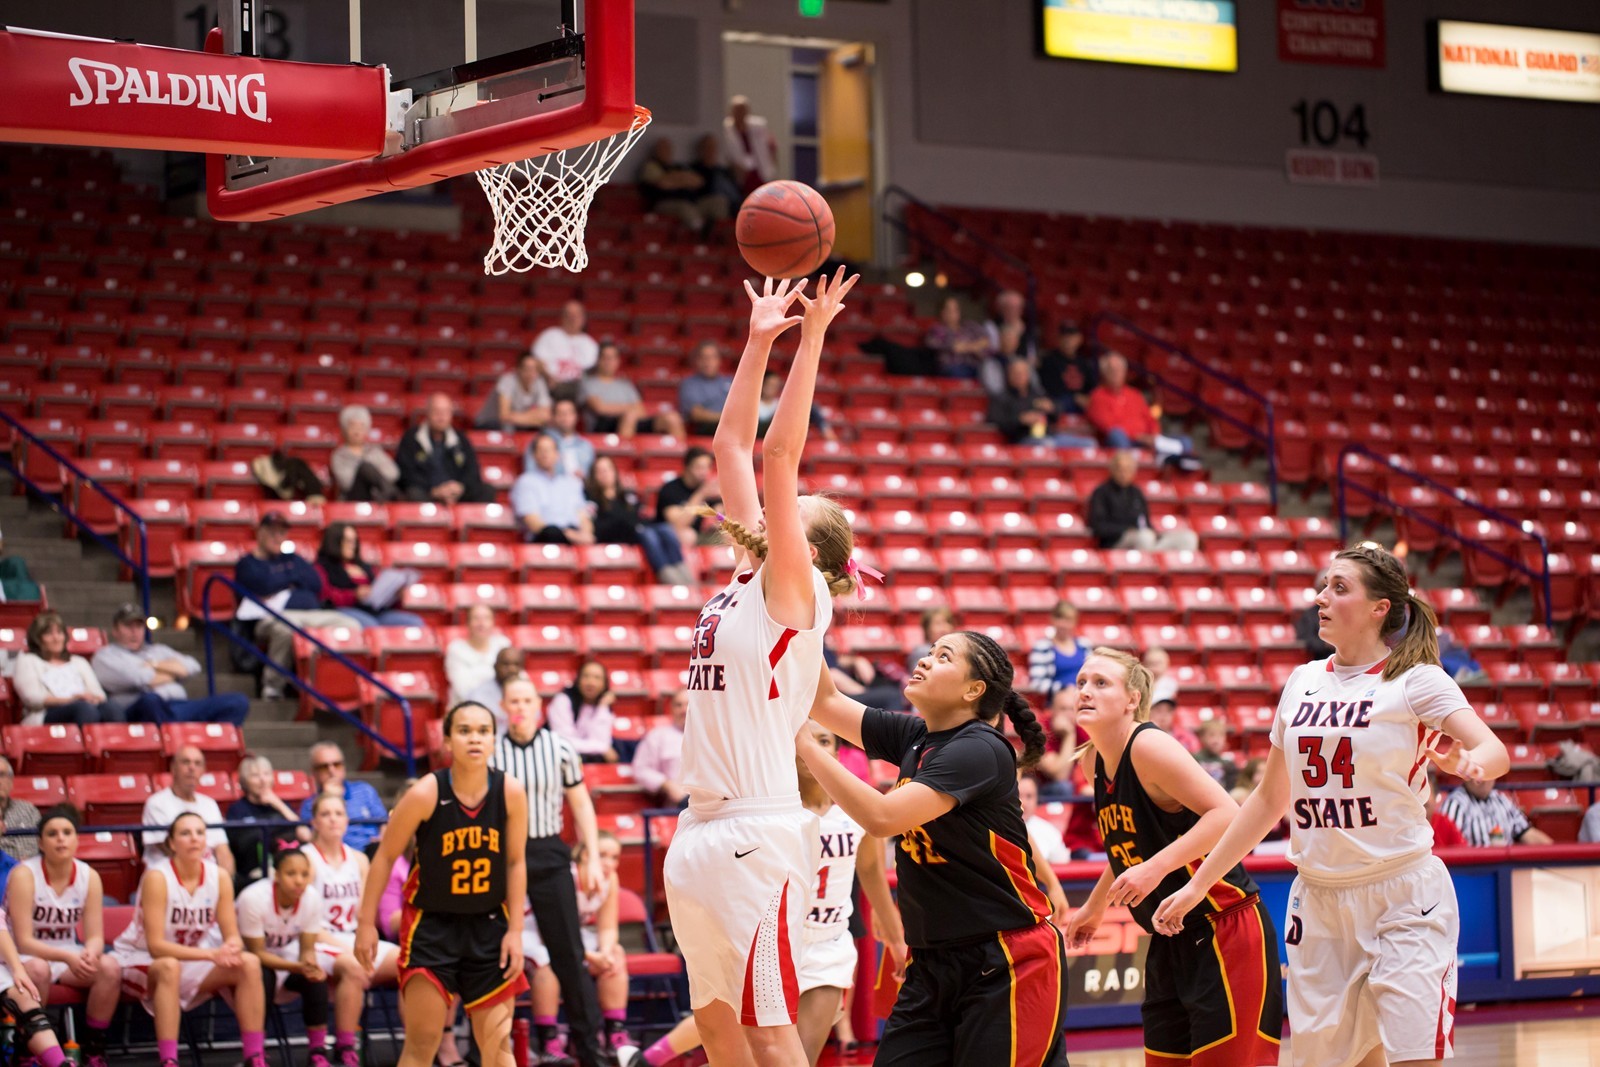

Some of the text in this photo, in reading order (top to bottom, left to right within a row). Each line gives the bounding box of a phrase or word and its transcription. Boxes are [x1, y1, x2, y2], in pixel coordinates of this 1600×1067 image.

[1443, 44, 1578, 72] NATIONAL GUARD
[69, 57, 269, 122] SPALDING
[1291, 99, 1369, 147] 104
[687, 664, 726, 691] TATE
[1290, 700, 1373, 728] DIXIE
[1298, 736, 1355, 788] 34
[1098, 804, 1137, 841] YU-H
[1294, 796, 1377, 829] STATE
[441, 825, 500, 857] BYU-H
[820, 833, 854, 858] XIE
[451, 857, 491, 894] 22
[33, 906, 82, 923] DIXIE
[171, 907, 213, 924] DIXIE
[1084, 967, 1145, 992] RAD
